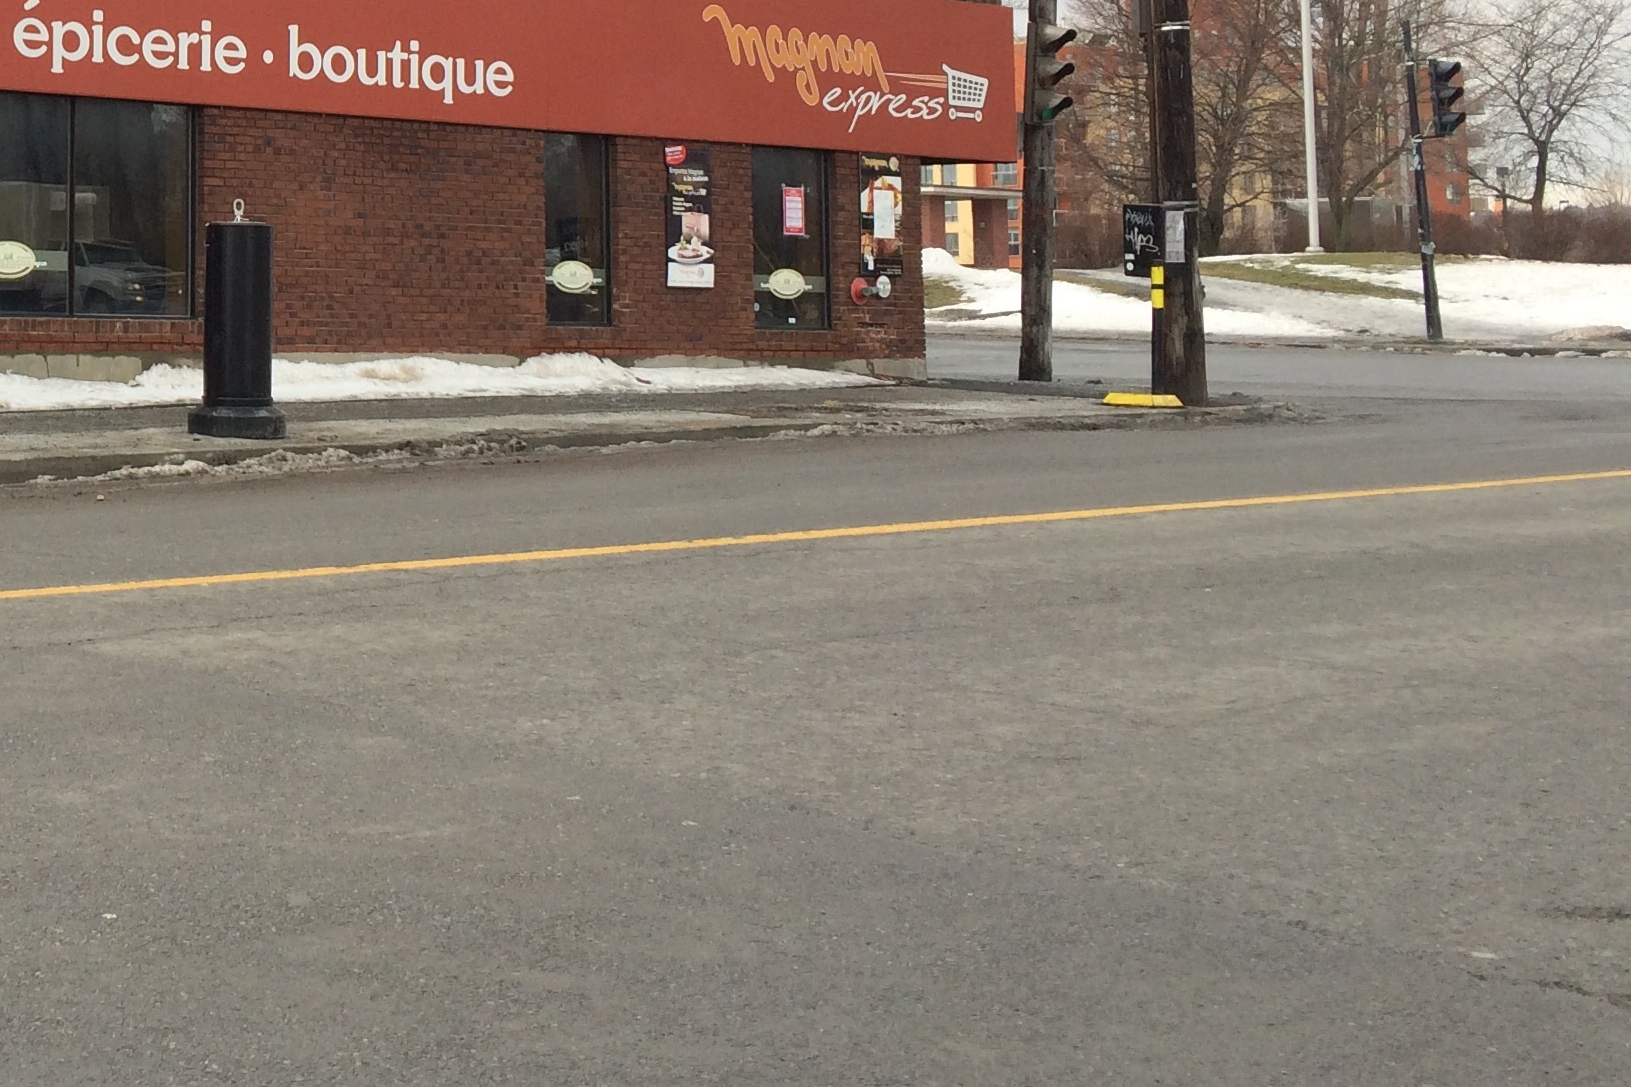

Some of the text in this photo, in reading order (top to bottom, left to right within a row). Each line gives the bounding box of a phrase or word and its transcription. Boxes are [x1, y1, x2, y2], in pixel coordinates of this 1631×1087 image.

[288, 24, 514, 104] boutique
[702, 4, 889, 106] magnan
[822, 86, 944, 133] express
